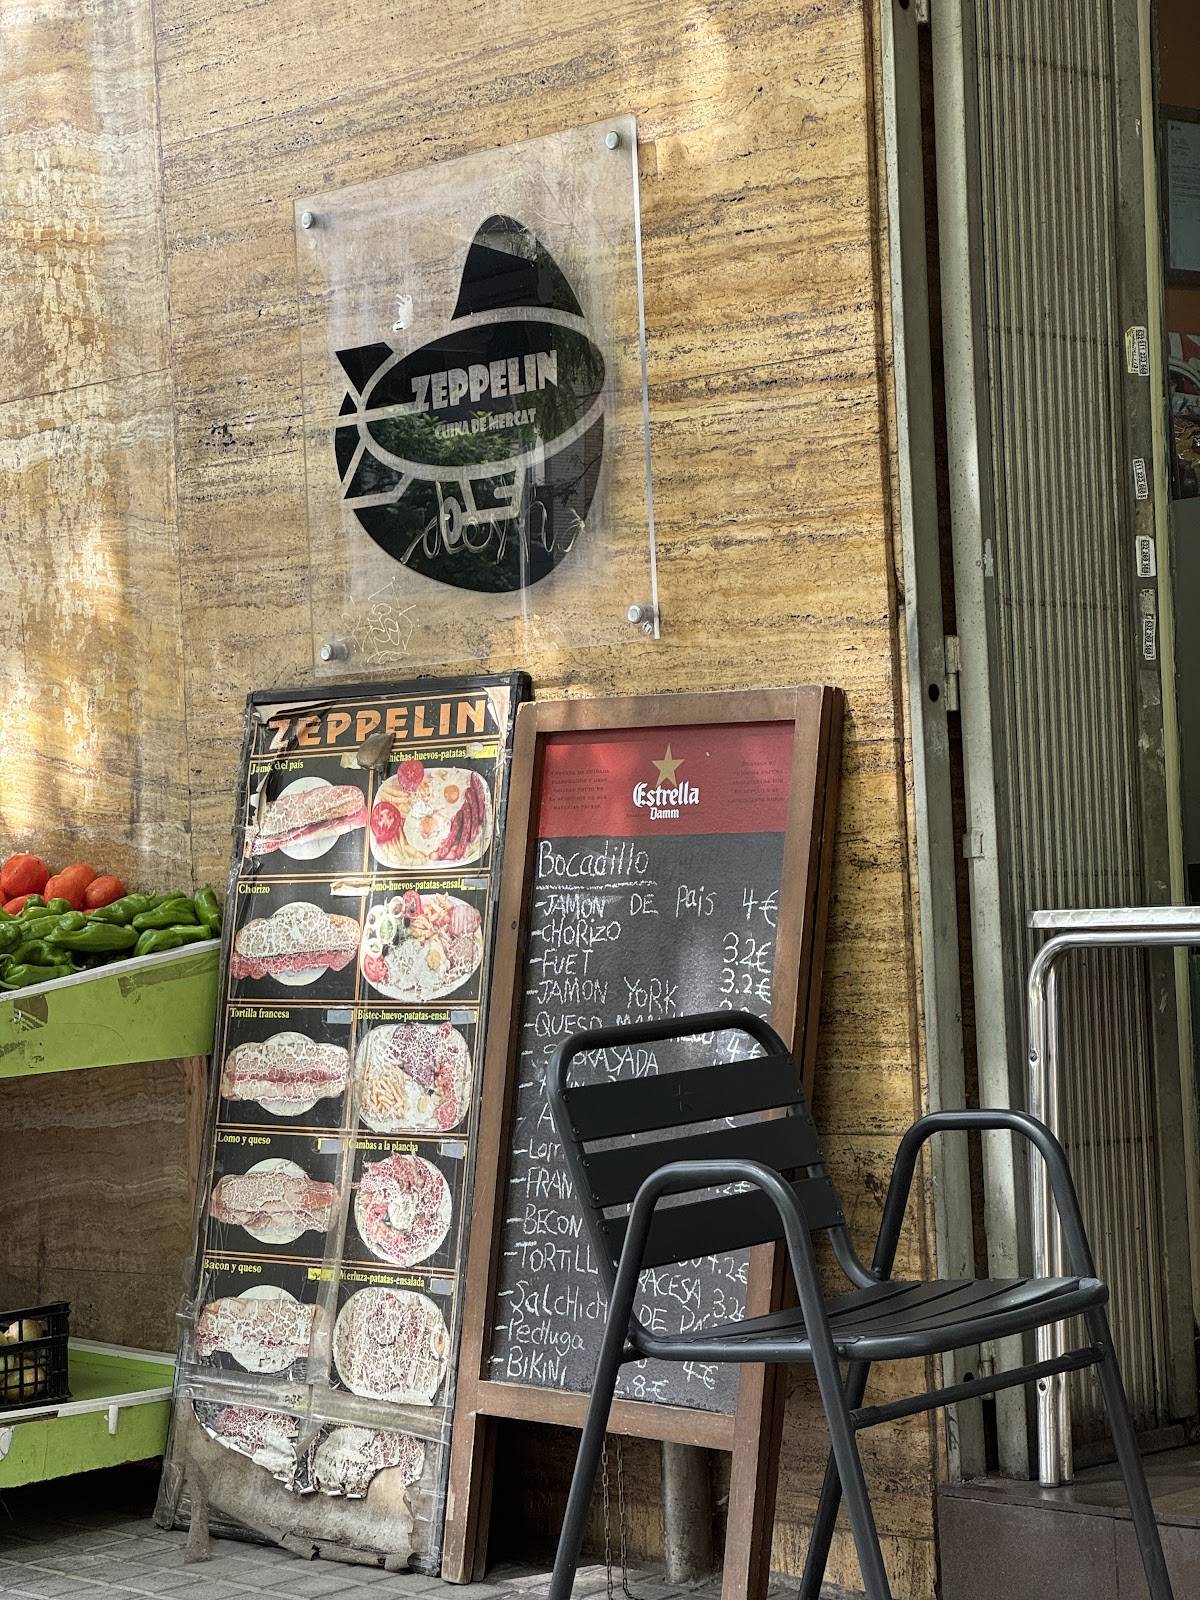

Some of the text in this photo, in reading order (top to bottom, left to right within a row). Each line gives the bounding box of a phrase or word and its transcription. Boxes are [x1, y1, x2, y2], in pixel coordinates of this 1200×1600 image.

[411, 350, 557, 412] ZEPPELIN
[434, 408, 537, 440] CUINA DE MERCAT
[268, 699, 487, 750] ZEPPELIN
[275, 760, 288, 770] del
[289, 759, 304, 771] país
[633, 781, 700, 808] Estrella
[649, 807, 680, 820] Damm
[538, 840, 649, 878] Bocadillo
[239, 883, 271, 894] Chorizo
[630, 892, 659, 916] DE
[623, 976, 679, 1016] YORK
[230, 1007, 290, 1019] Tortilla francesa
[217, 1131, 271, 1147] Lomo y queso
[378, 1142, 383, 1150] a
[383, 1140, 391, 1151] la
[391, 1140, 419, 1153] plancha
[203, 1258, 262, 1275] Bacon y queso
[639, 1304, 669, 1332] DE
